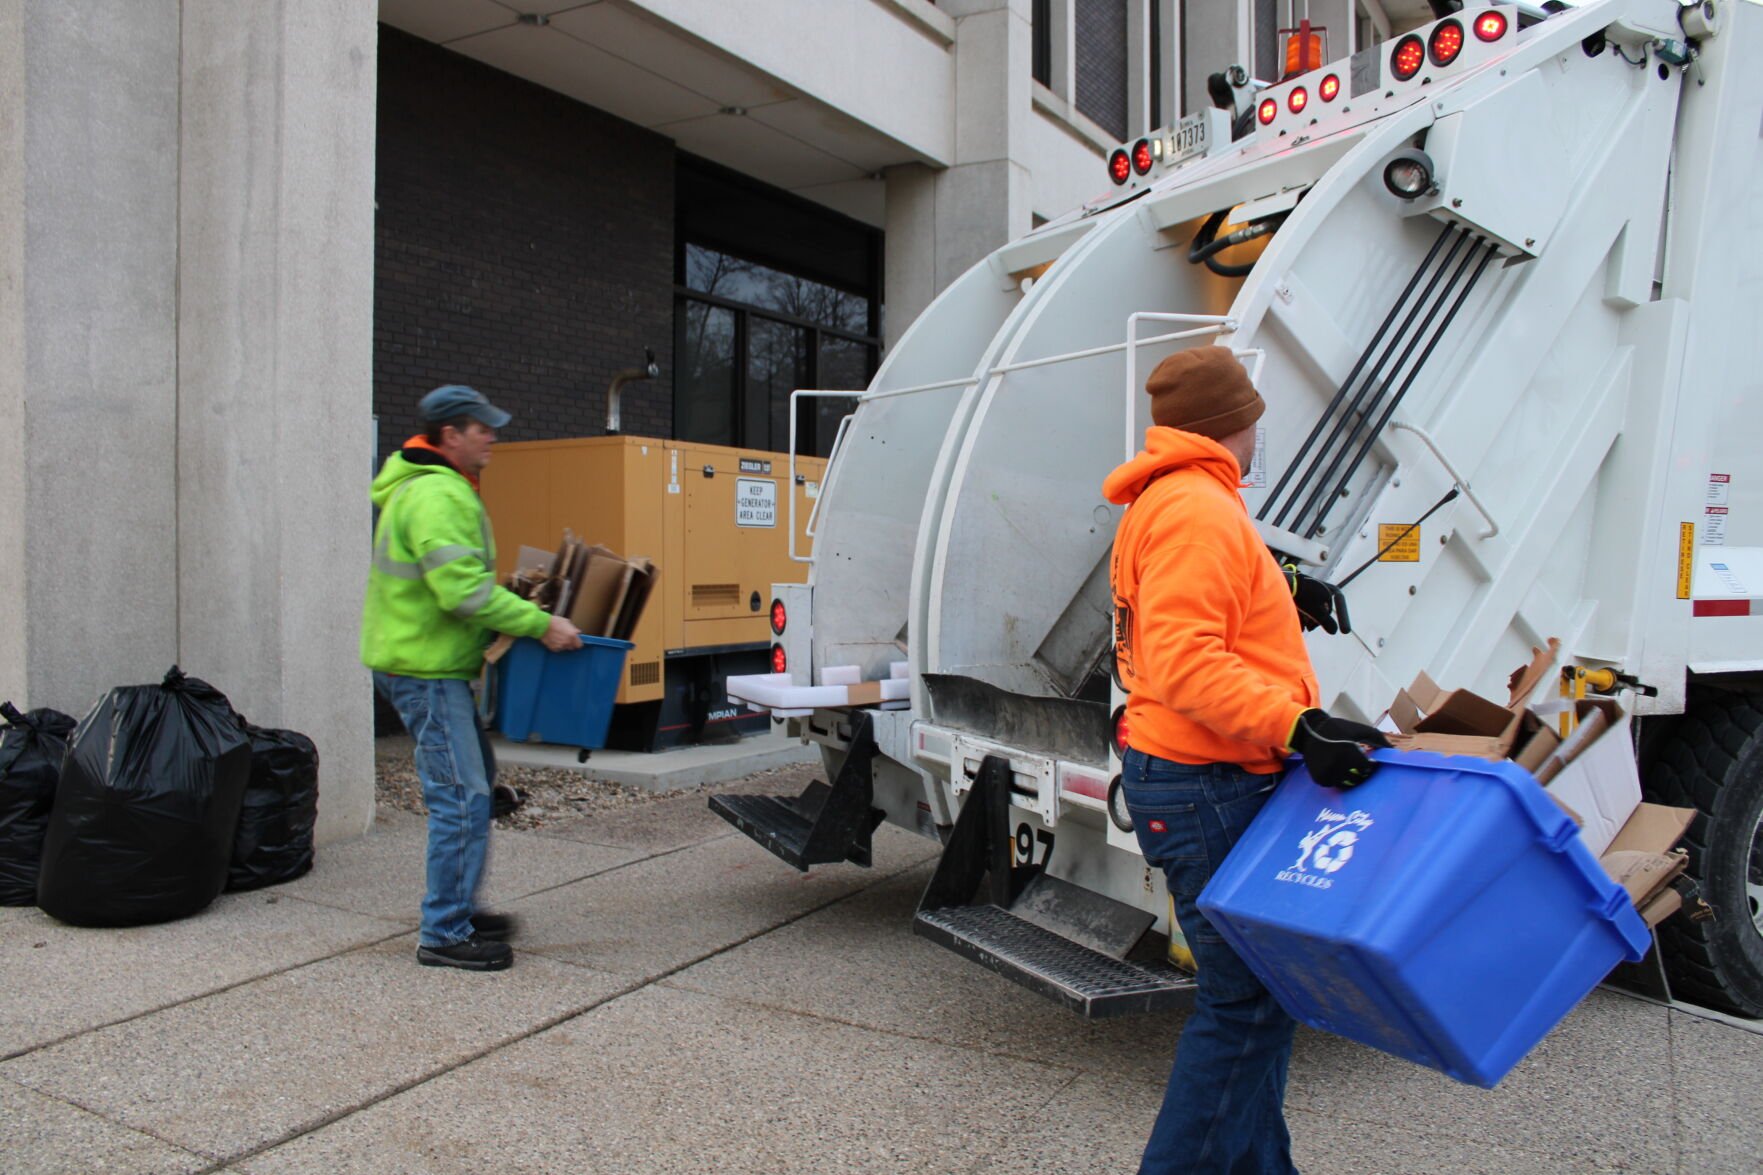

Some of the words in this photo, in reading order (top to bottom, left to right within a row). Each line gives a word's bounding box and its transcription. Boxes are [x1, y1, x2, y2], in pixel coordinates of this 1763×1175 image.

[1171, 122, 1205, 154] 107373
[749, 486, 763, 496] KEEP
[740, 497, 771, 509] GENERATOR
[739, 510, 753, 520] AREA
[755, 511, 773, 521] CLEAR
[708, 708, 738, 721] MPIAN
[1016, 823, 1055, 874] 97
[1274, 870, 1334, 890] RECYCLES
